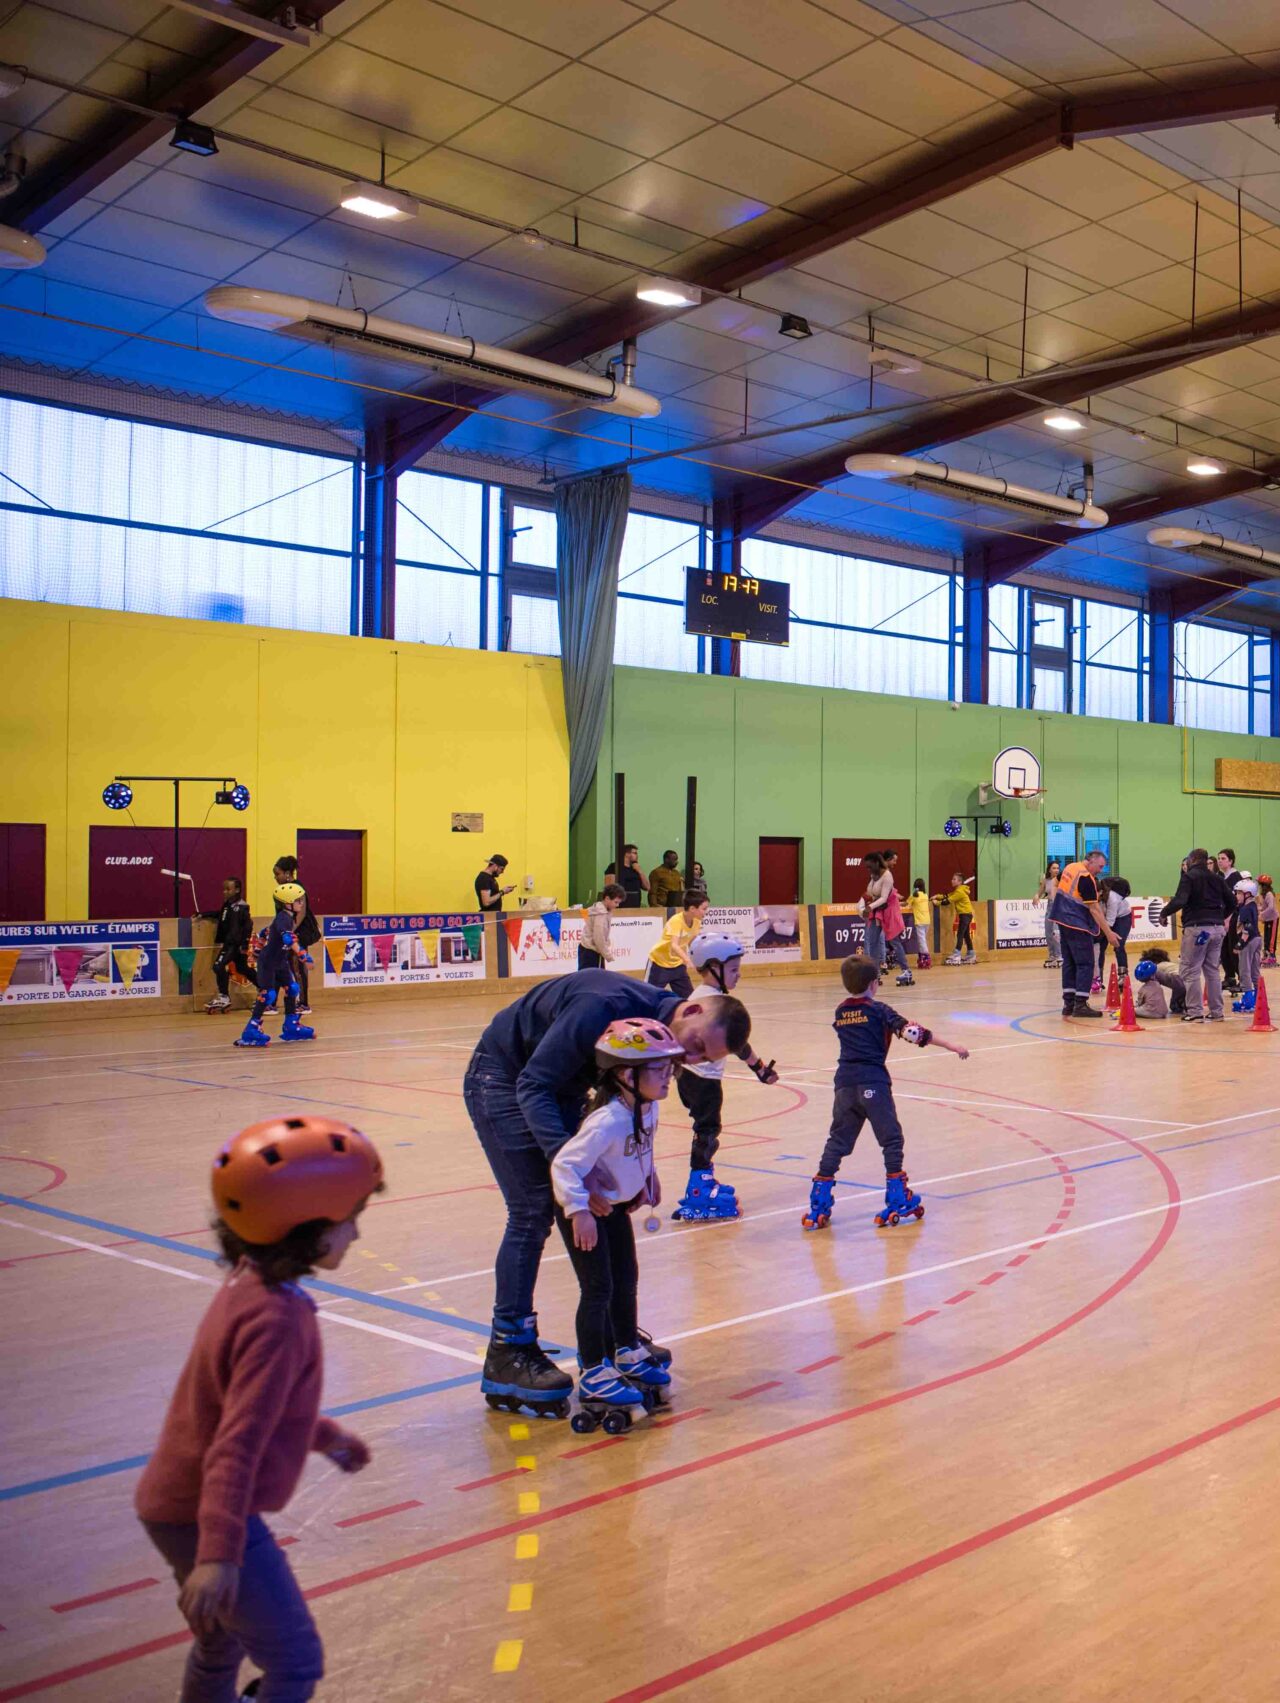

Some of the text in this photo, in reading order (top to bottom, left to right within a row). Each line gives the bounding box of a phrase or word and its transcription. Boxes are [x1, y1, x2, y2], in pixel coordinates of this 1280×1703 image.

[701, 594, 719, 605] LOC.
[759, 602, 778, 614] VISIT.
[105, 856, 153, 865] CLUB.ADOS
[705, 909, 726, 917] ÇOIS
[390, 918, 405, 929] 01
[409, 917, 425, 928] 69
[428, 917, 444, 928] 80
[447, 916, 462, 926] 60
[0, 926, 31, 936] URES
[34, 925, 57, 936] SUR
[59, 924, 99, 935] YVETTE
[108, 923, 155, 933] ÉTAMPES
[835, 928, 865, 942] 09 72
[342, 971, 474, 984] FENÊTRES PORTES VOLETS
[17, 992, 50, 1001] PORTE
[52, 991, 66, 999] DE
[68, 988, 107, 998] GARAGE
[842, 1010, 862, 1018] VISIT
